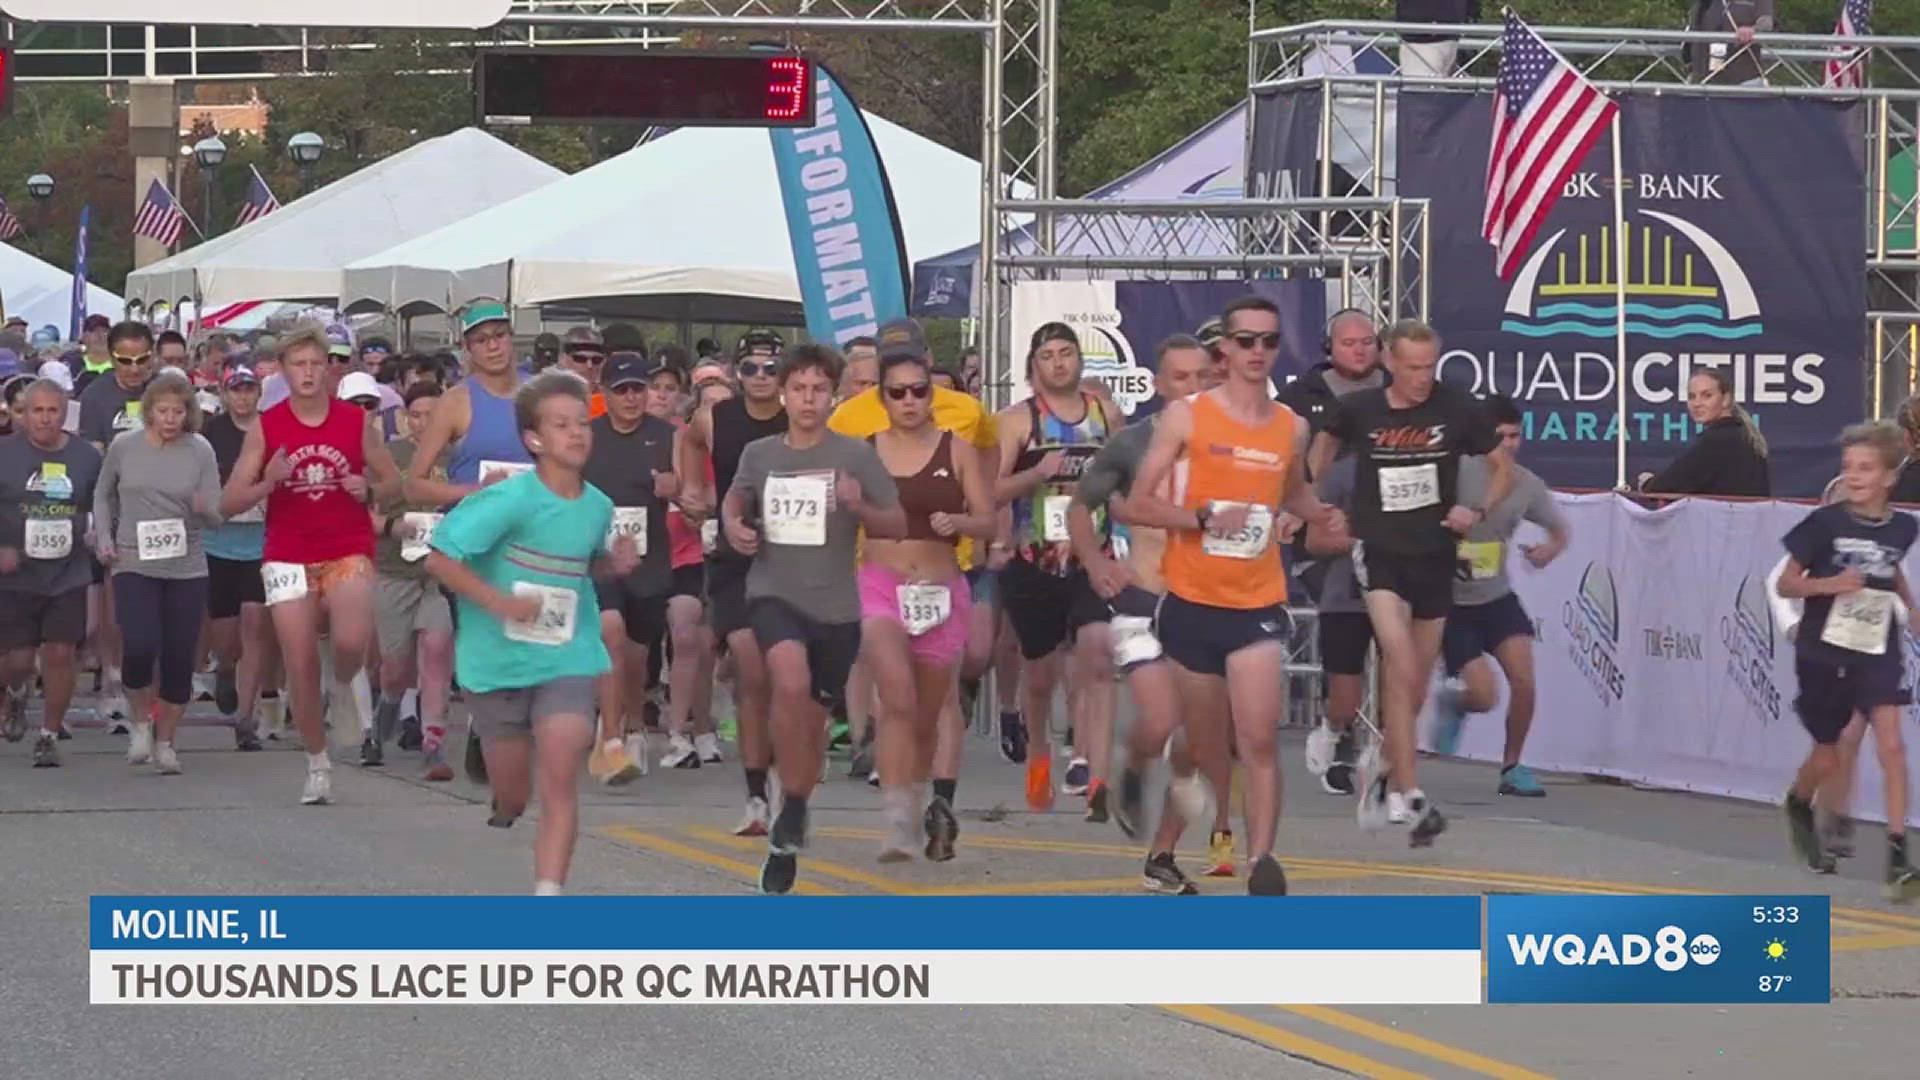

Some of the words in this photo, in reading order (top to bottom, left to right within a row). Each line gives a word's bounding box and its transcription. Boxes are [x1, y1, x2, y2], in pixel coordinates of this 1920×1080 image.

[765, 60, 803, 117] 3
[1562, 171, 1600, 198] BK
[1639, 173, 1724, 200] BANK
[1102, 375, 1148, 394] TIES
[1435, 349, 1616, 401] QUAD
[1518, 411, 1760, 442] MARATH
[1387, 480, 1432, 499] 3576
[769, 498, 819, 517] 3173
[32, 534, 67, 549] 3559
[144, 533, 181, 549] 3597
[903, 604, 941, 622] 3331
